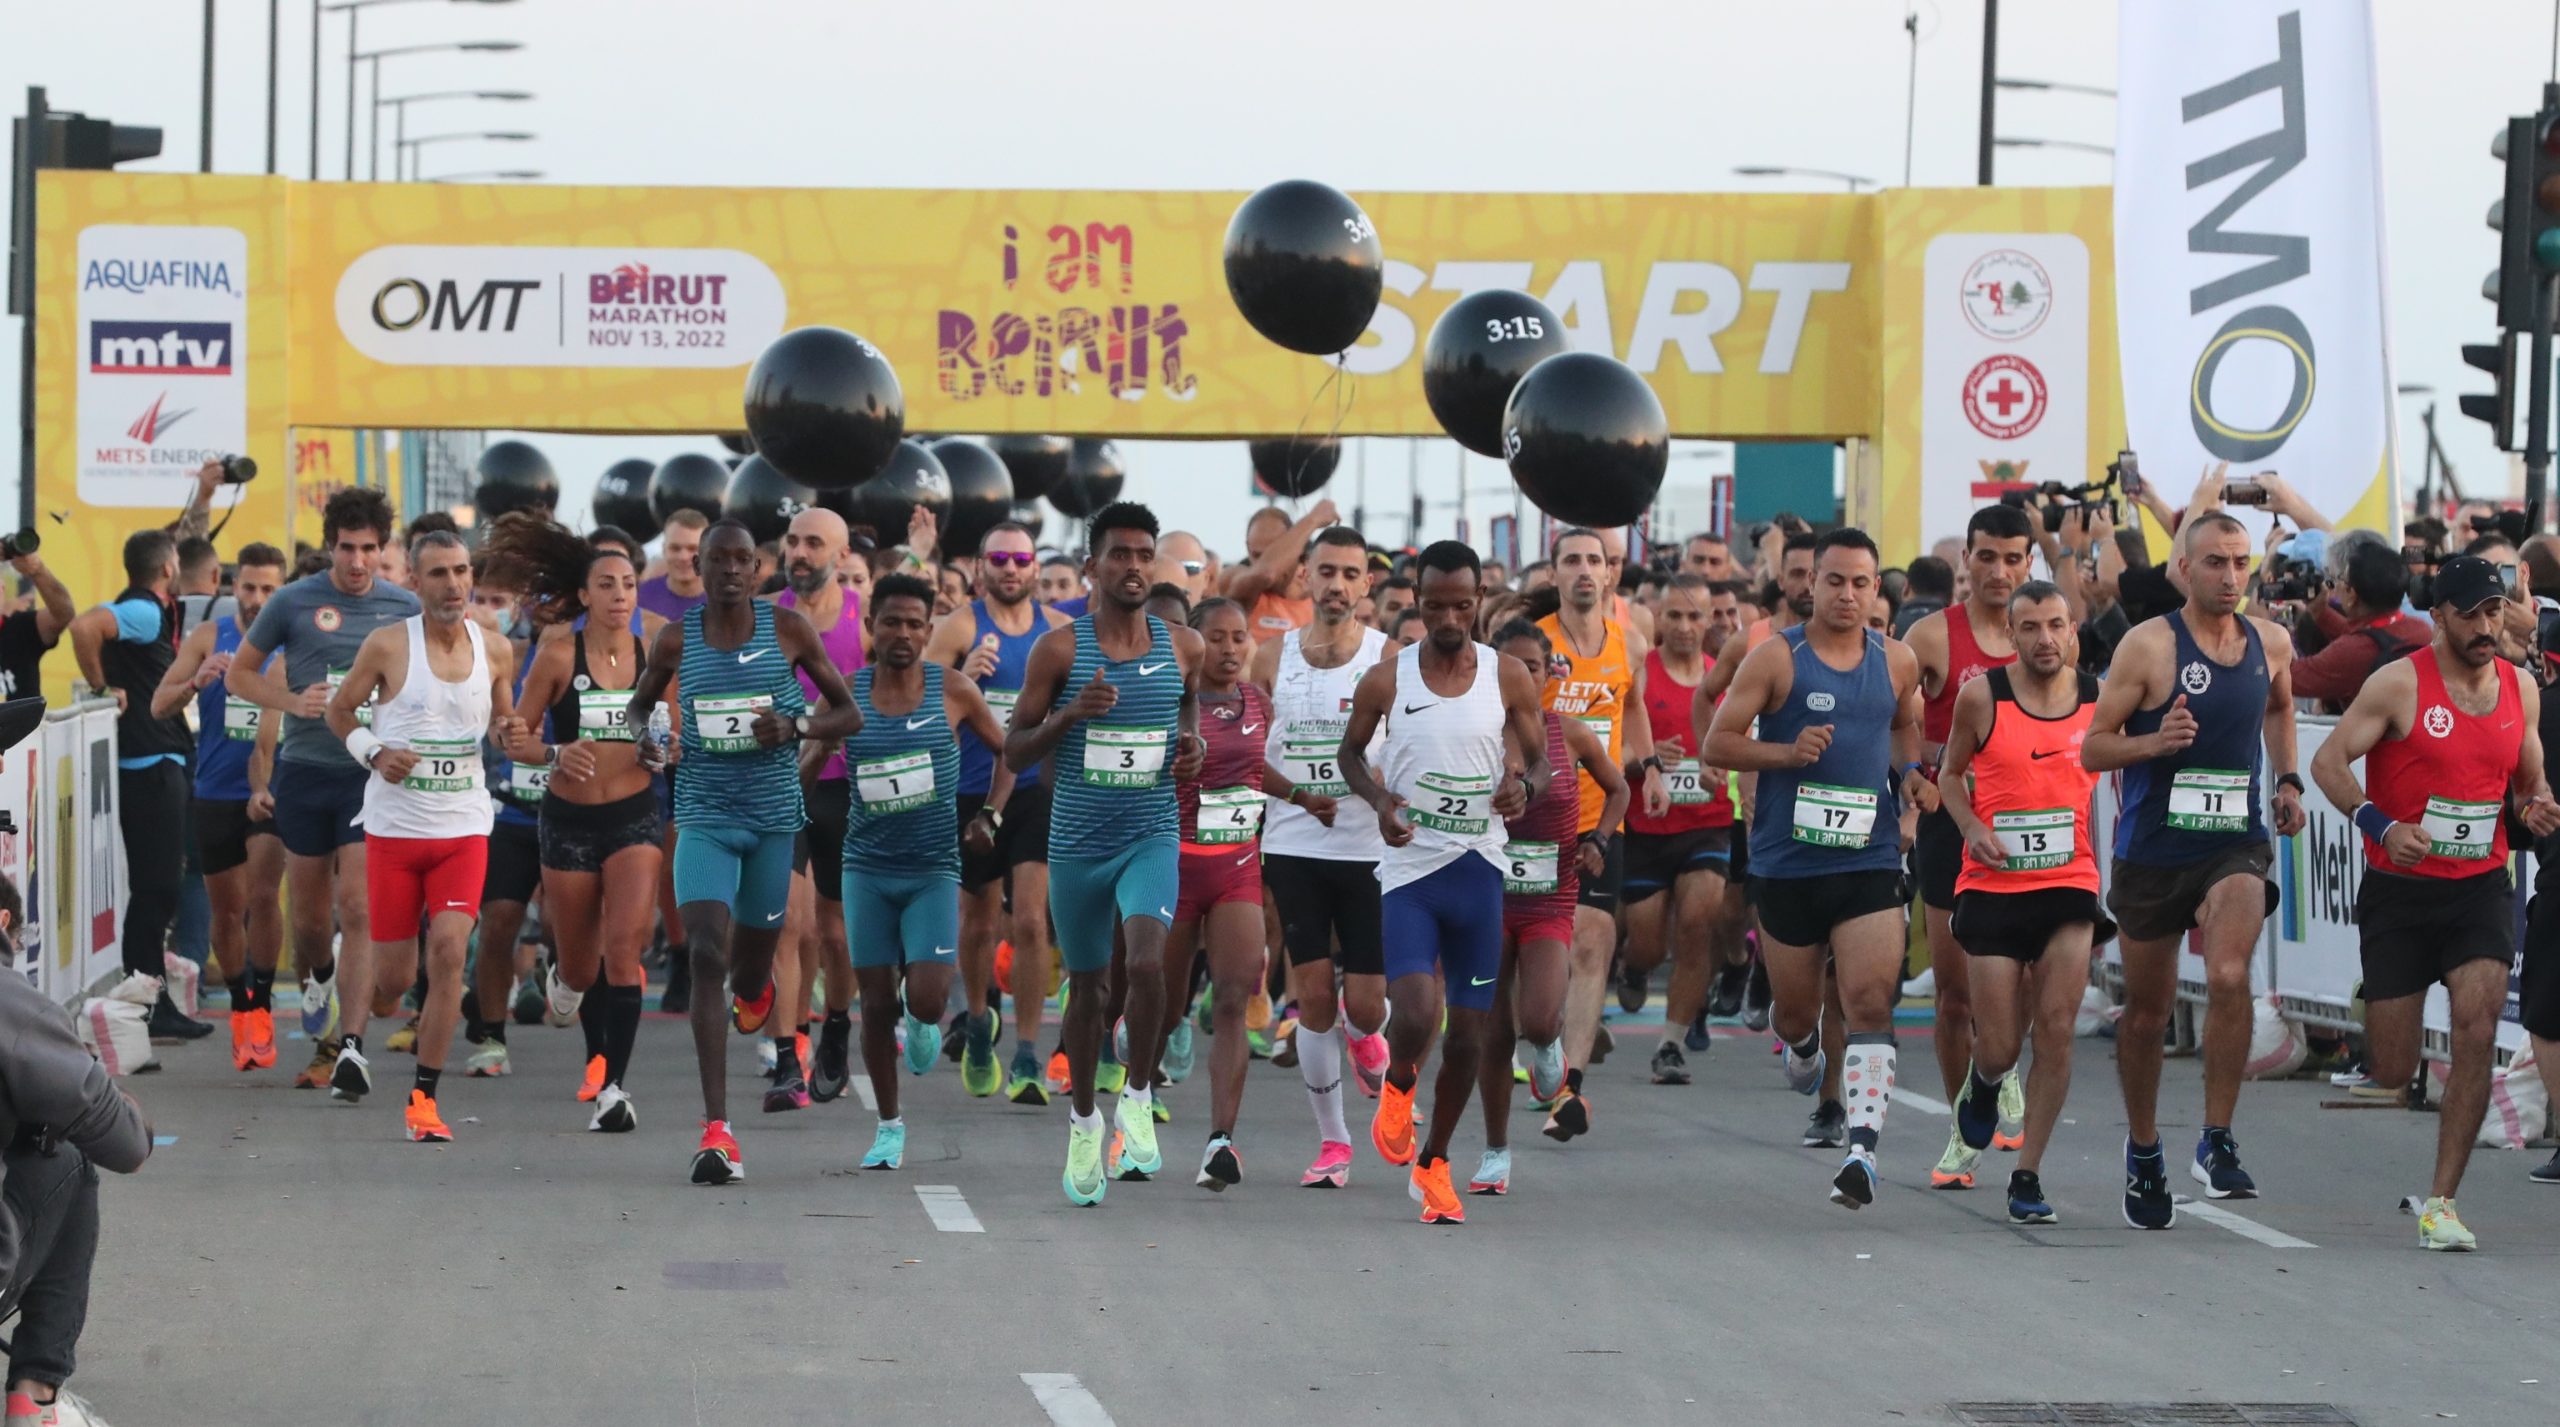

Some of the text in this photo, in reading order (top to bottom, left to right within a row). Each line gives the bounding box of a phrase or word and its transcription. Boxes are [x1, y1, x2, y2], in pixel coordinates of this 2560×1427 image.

[2181, 9, 2316, 463] OMT
[84, 259, 231, 294] AQUAFINA
[588, 273, 727, 306] BEIRUT
[371, 277, 541, 332] OMT
[588, 308, 727, 325] MARATHON
[1486, 316, 1544, 343] 3:15
[588, 329, 726, 349] NOV 13, 2022
[101, 329, 225, 368] mtv
[96, 449, 146, 463] METS
[1552, 697, 1590, 713] RUN
[606, 710, 627, 726] 19
[726, 716, 741, 734] 2
[705, 740, 713, 749] A
[432, 760, 456, 776] 10
[1120, 750, 1135, 769] 3
[1090, 772, 1100, 782] A
[1308, 762, 1334, 781] 16
[410, 780, 419, 789] A
[889, 778, 900, 795] 1
[1671, 775, 1696, 790] 70
[1437, 796, 1468, 816] 22
[2203, 793, 2223, 813] 11
[1231, 807, 1247, 826] 4
[1412, 813, 1423, 823] A
[1824, 808, 1850, 828] 17
[2175, 816, 2184, 826] A
[1204, 832, 1213, 841] A
[2454, 823, 2471, 840] 9
[2020, 833, 2047, 852] 13
[1512, 861, 1526, 878] 6
[2310, 810, 2362, 926] MetL
